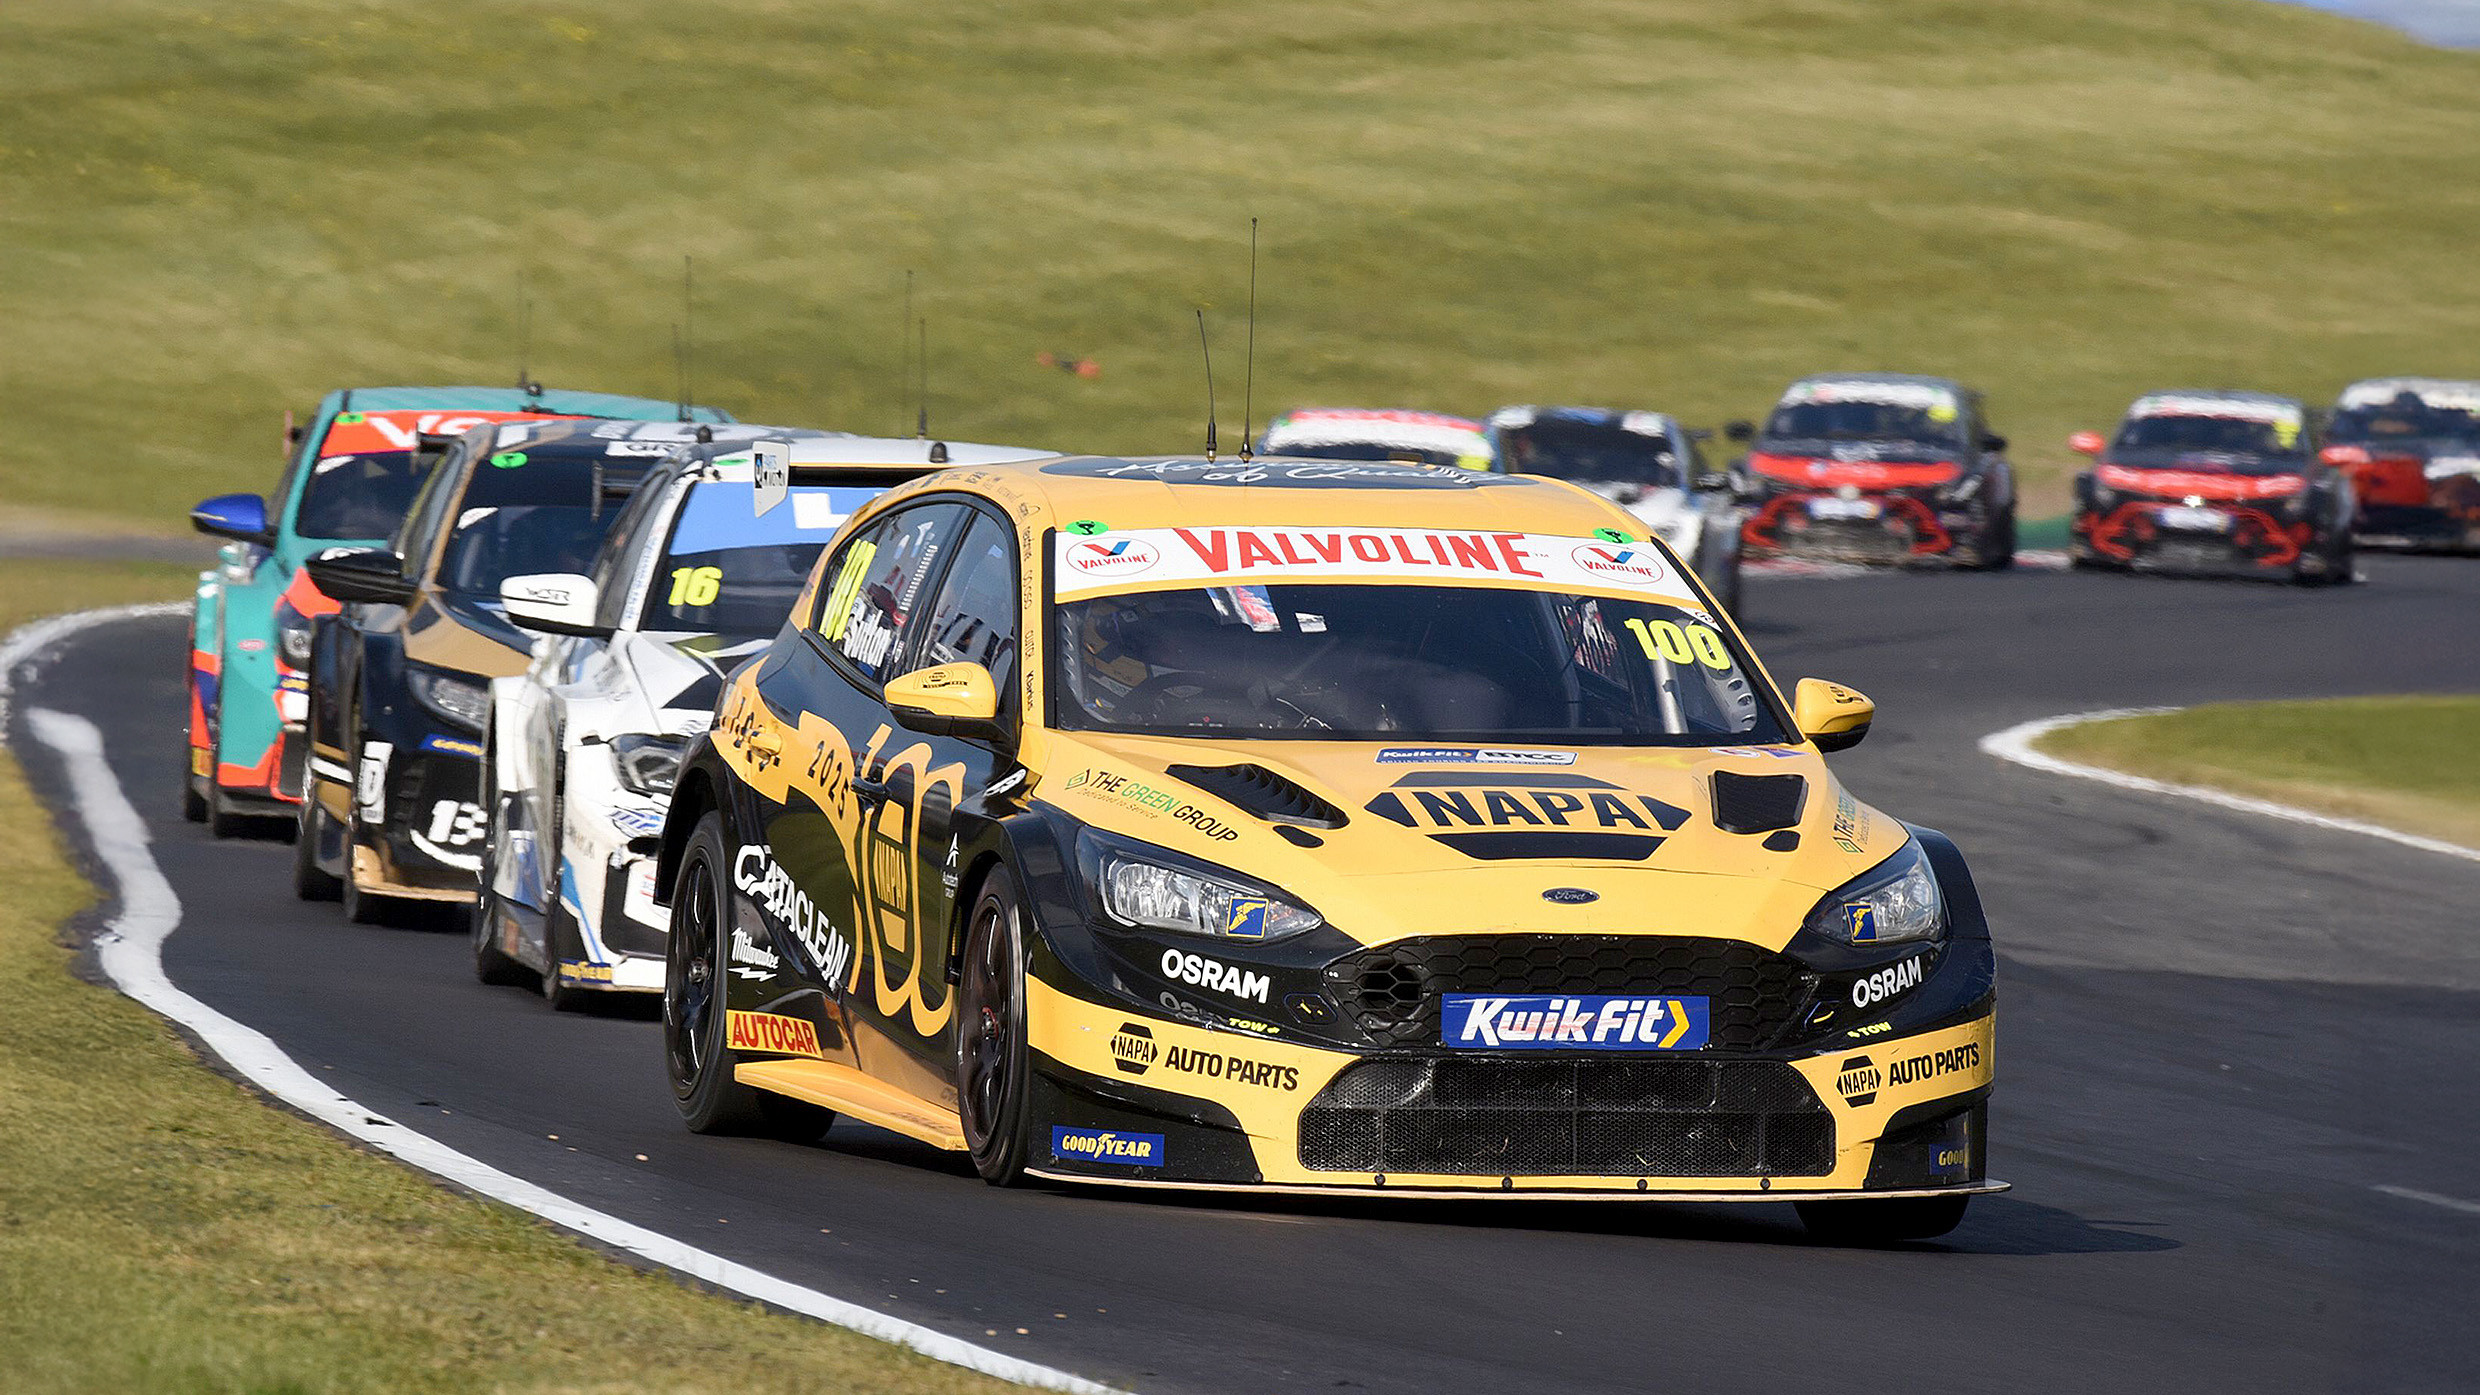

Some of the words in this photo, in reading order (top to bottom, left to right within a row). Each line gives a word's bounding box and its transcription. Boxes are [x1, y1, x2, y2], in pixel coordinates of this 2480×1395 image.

[1077, 553, 1151, 569] VALVOLINE
[1172, 527, 1544, 579] VALVOLINE
[1582, 559, 1656, 578] VALVOLINE
[668, 566, 723, 606] 16
[1624, 618, 1731, 669] 100
[808, 740, 849, 820] 2025
[1090, 771, 1127, 793] THE
[1121, 782, 1180, 812] GREEN
[1173, 805, 1239, 843] GROUP
[1411, 790, 1652, 830] NAPA
[734, 844, 851, 992] CATACLEAN
[1161, 949, 1270, 1004] OSRAM
[1853, 956, 1922, 1008] OSRAM
[732, 1013, 818, 1055] AUTOCAR
[1228, 1017, 1268, 1032] TOW
[1858, 1021, 1893, 1036] TOW
[1115, 1035, 1151, 1062] NAPA
[1164, 1046, 1223, 1077] AUTO
[1226, 1060, 1299, 1091] PARTS
[1843, 1069, 1877, 1095] NAPA
[1888, 1056, 1933, 1087] AUTO
[1936, 1042, 1980, 1078] PARTS
[1062, 1133, 1153, 1158] GOODYEAR
